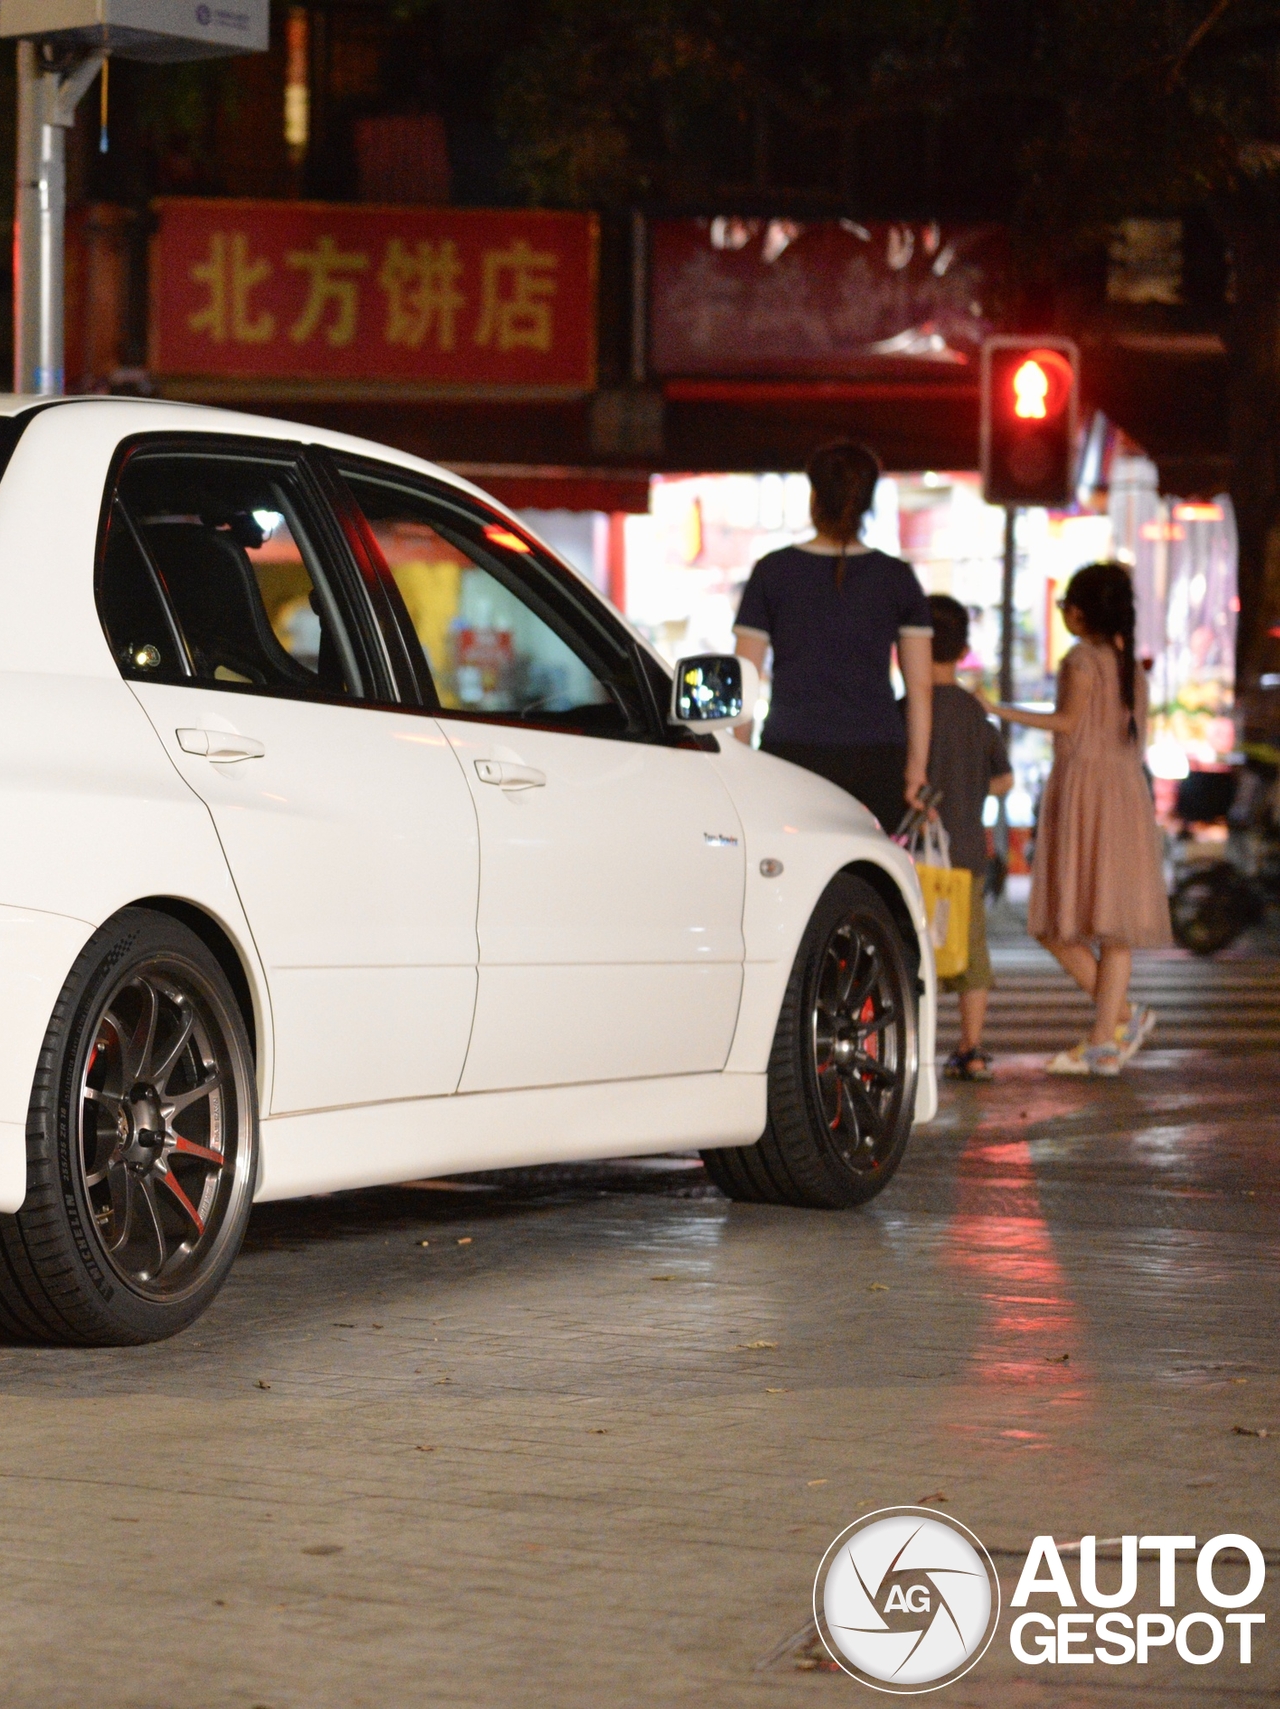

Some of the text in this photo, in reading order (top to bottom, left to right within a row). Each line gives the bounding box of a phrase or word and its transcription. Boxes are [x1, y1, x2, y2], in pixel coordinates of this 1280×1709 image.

[187, 232, 558, 352] 北方饼店
[64, 1194, 100, 1281] MICHELIN
